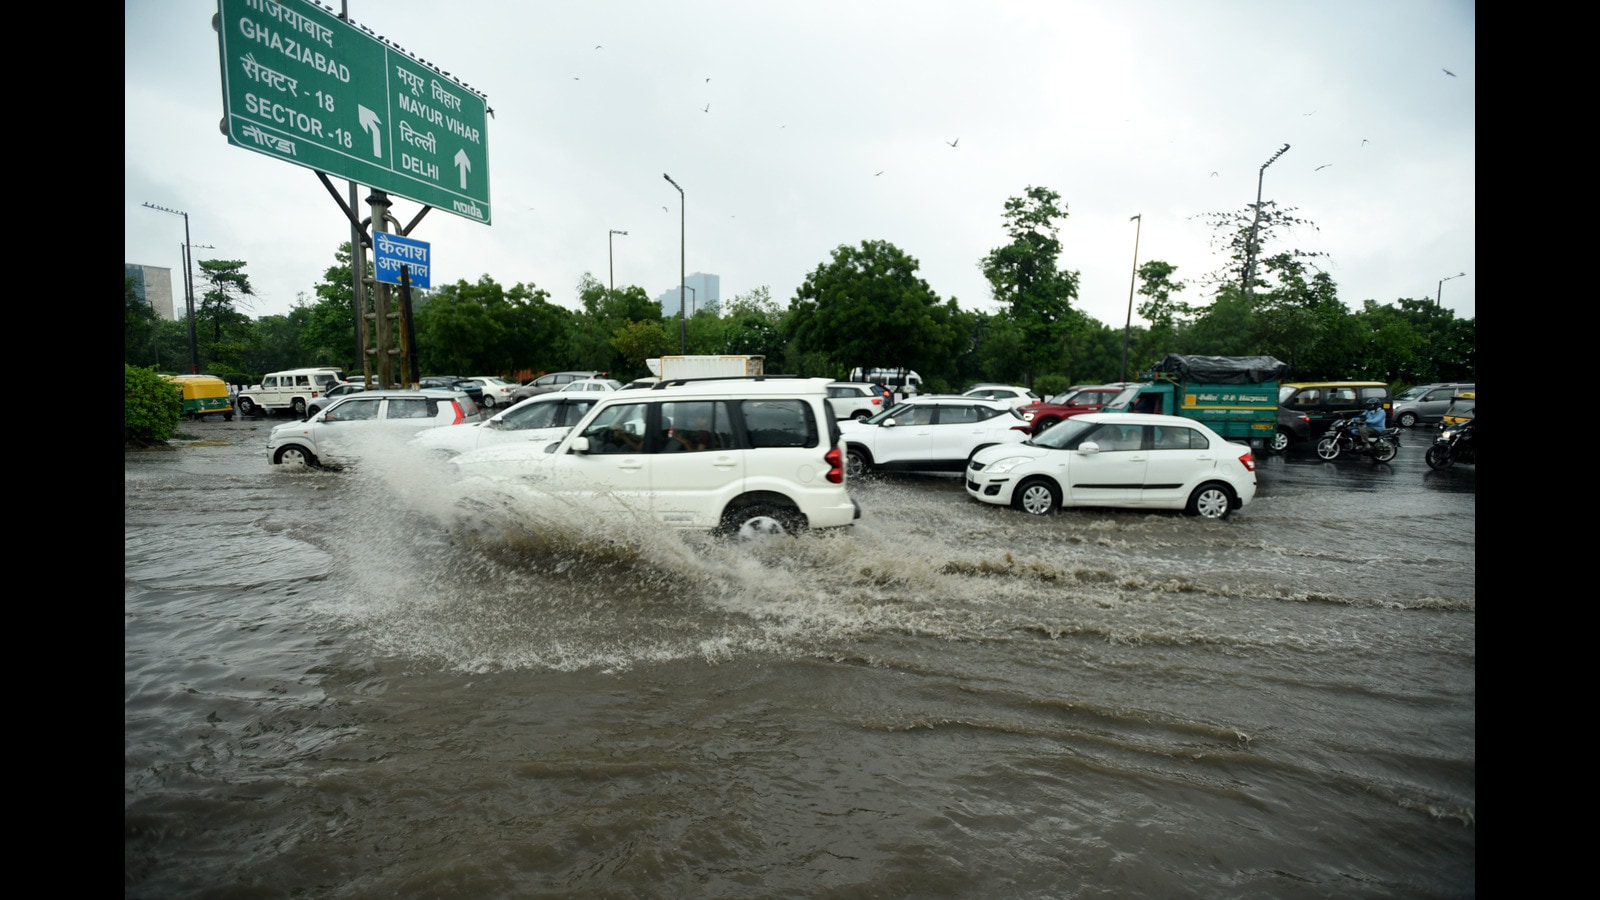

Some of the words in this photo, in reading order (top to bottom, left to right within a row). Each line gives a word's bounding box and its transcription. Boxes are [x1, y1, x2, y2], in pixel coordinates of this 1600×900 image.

[239, 17, 351, 83] GHAZIABAD
[240, 52, 298, 97] सैक्टर
[315, 90, 335, 112] 18
[396, 65, 425, 97] मयूर
[431, 79, 462, 112] विहार
[245, 93, 323, 138] SECTOR
[399, 92, 443, 127] MAYUR
[445, 115, 480, 144] VIHAR
[399, 119, 437, 154] दिल्ली
[402, 152, 439, 180] DELHI
[377, 234, 427, 262] कैलाश
[378, 256, 428, 278] अस्ताल
